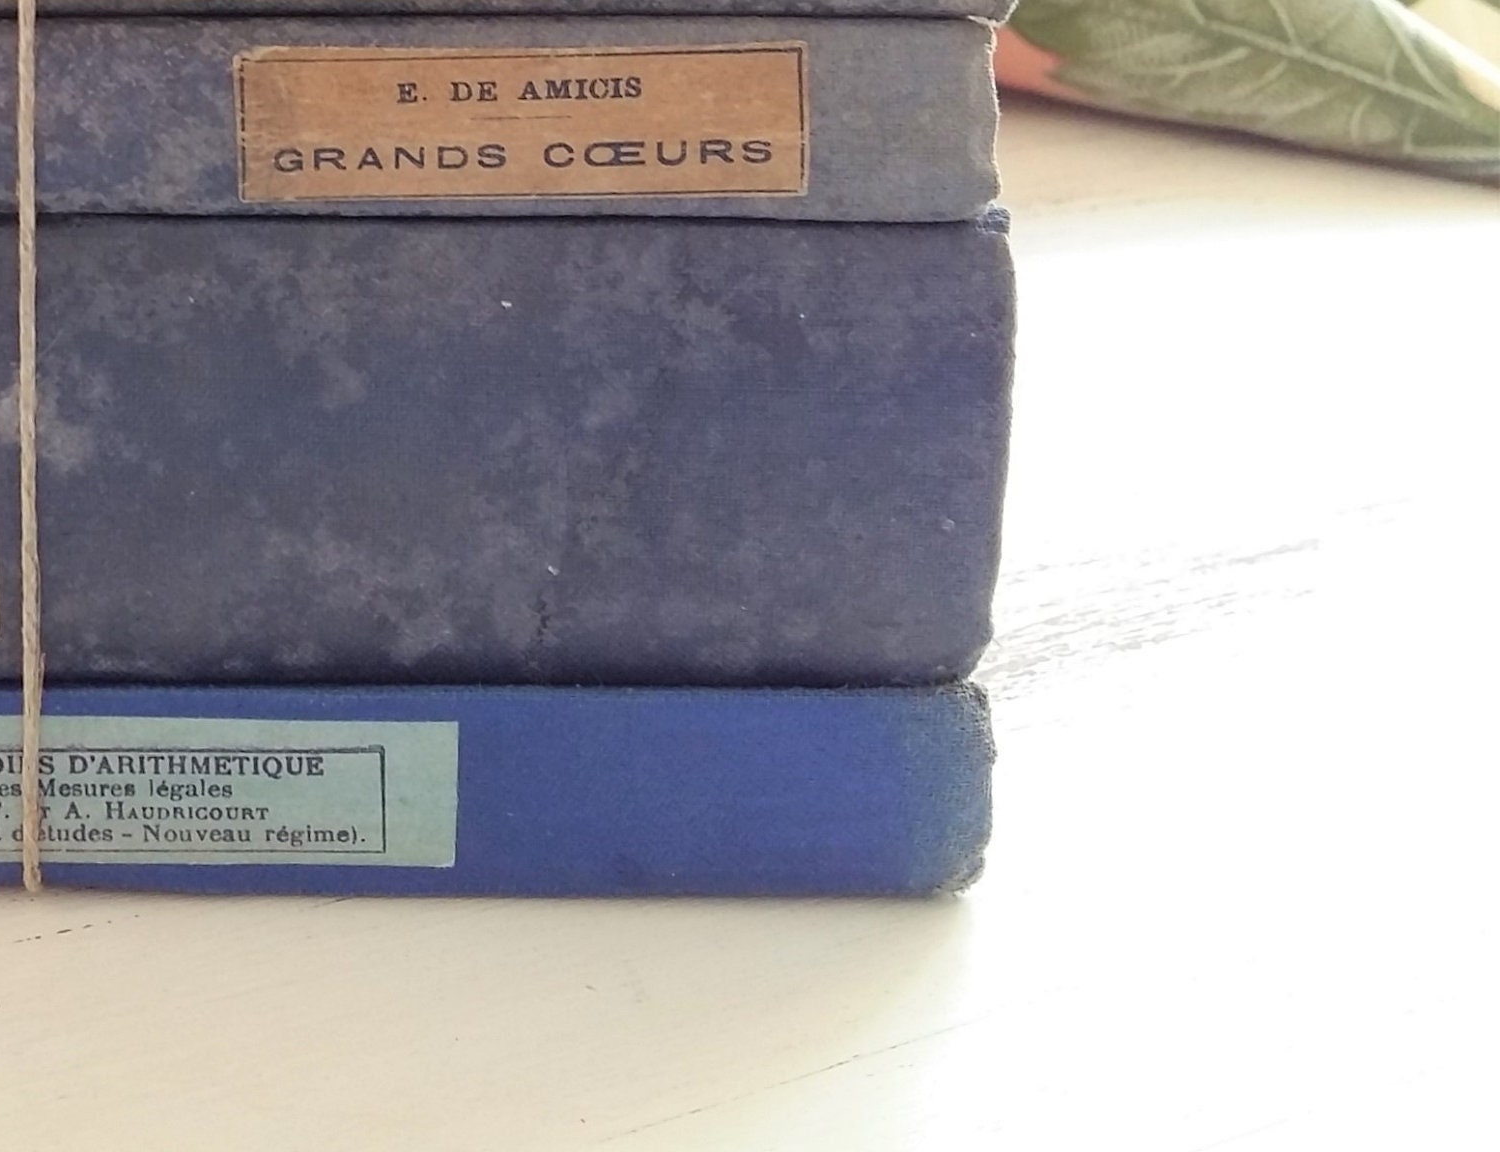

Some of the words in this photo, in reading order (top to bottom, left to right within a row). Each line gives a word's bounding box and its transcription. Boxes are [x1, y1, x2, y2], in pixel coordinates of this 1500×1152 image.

[397, 81, 427, 104] E.
[451, 80, 498, 102] DE
[518, 76, 642, 101] AMICIS
[274, 144, 506, 173] GRANDS
[543, 139, 773, 168] CŒURS
[36, 777, 136, 797] Mesures
[149, 778, 233, 802] légales
[64, 801, 91, 820] A.
[142, 824, 252, 843] Nouveau
[265, 823, 367, 847] régime).
